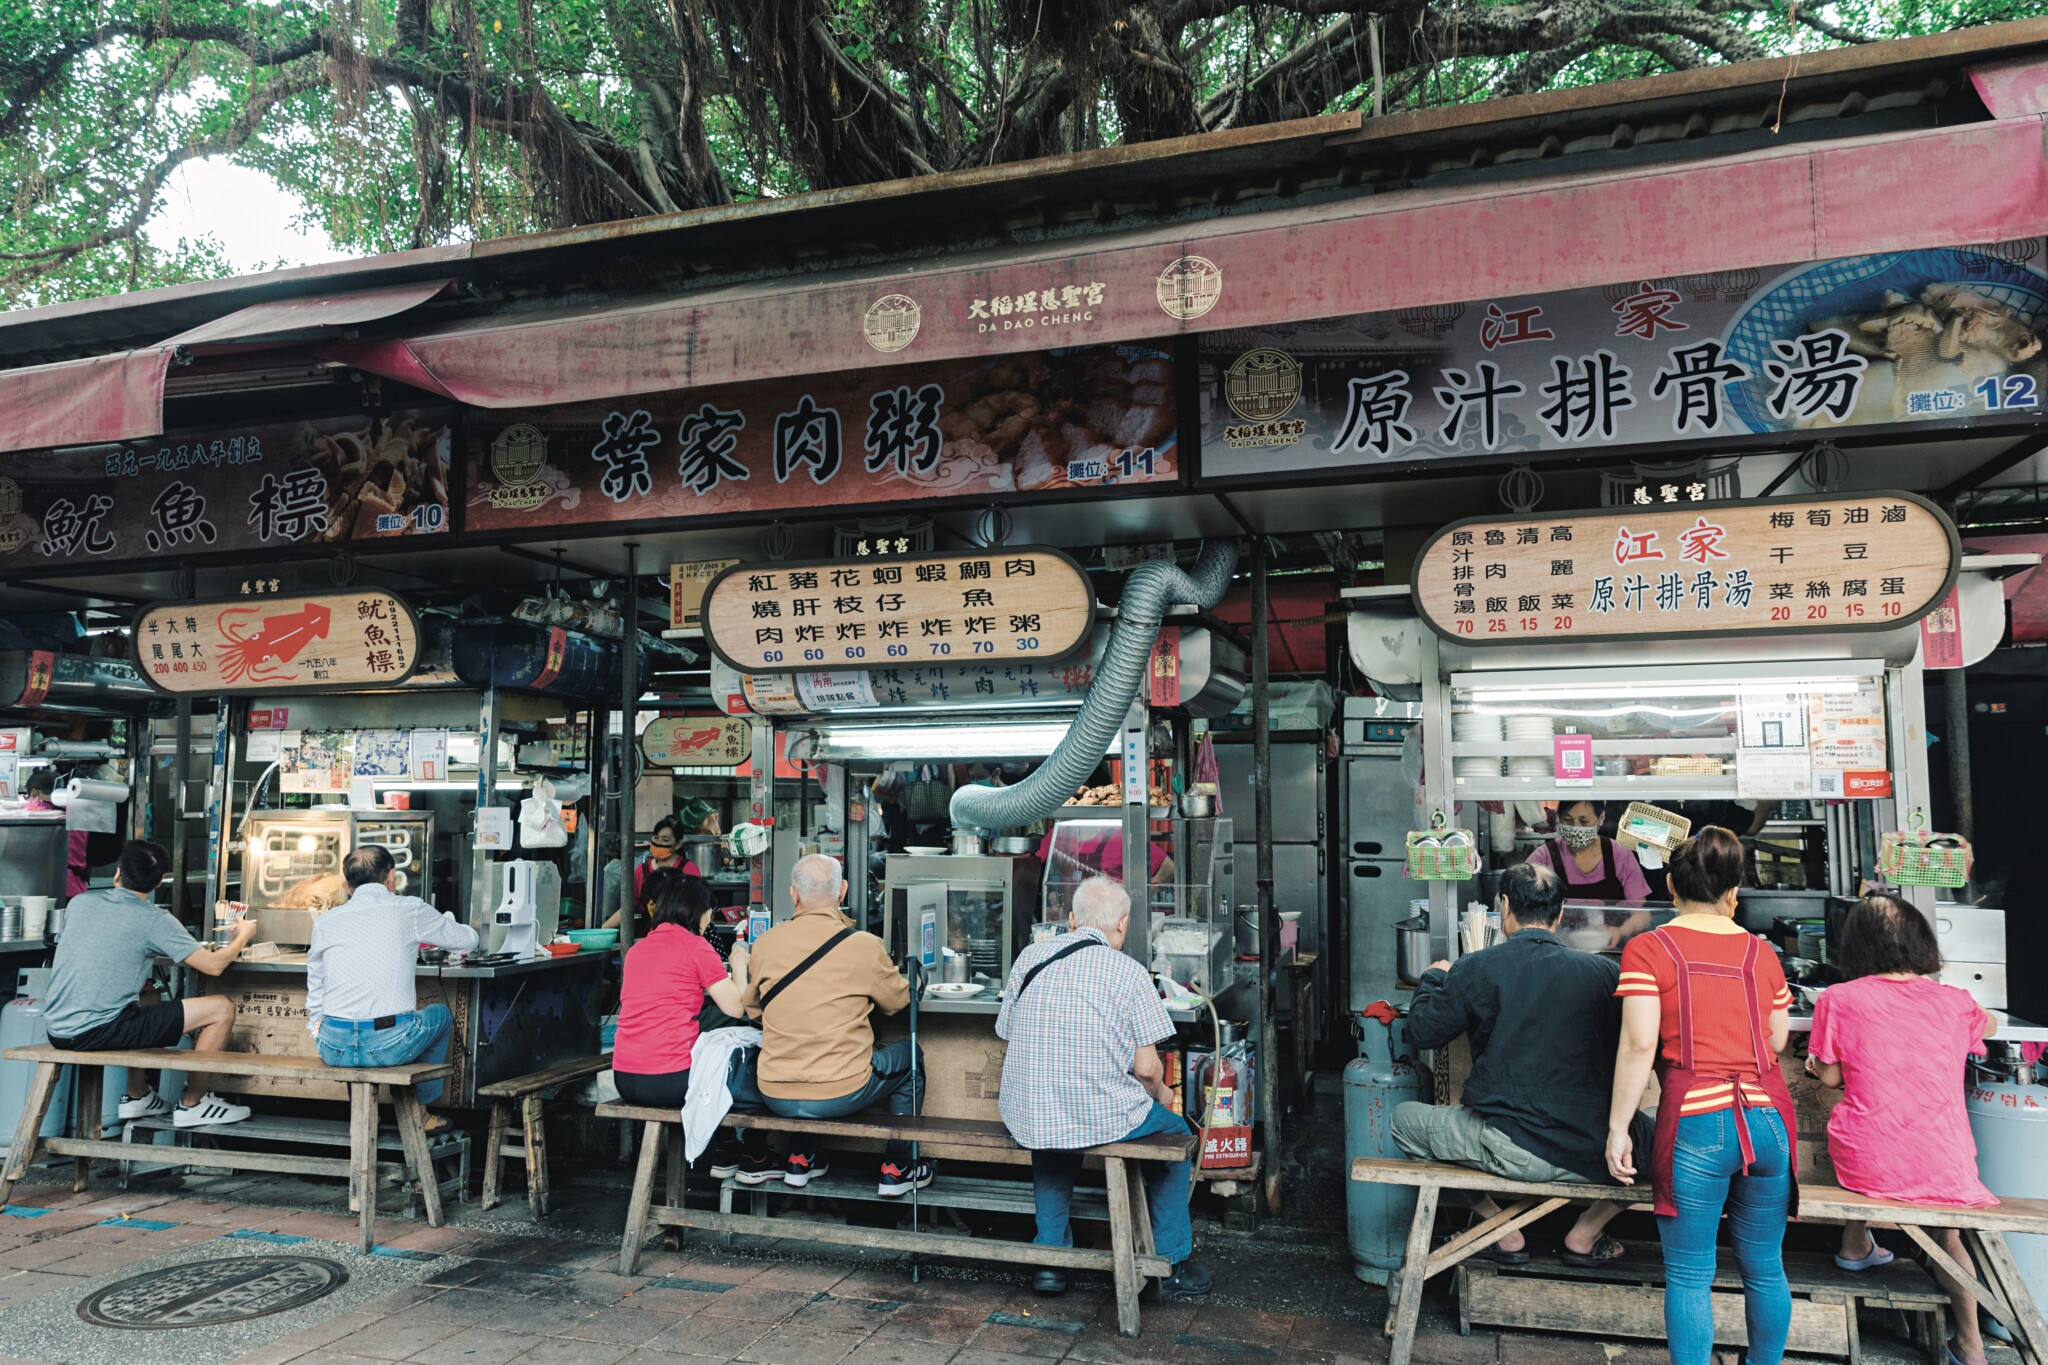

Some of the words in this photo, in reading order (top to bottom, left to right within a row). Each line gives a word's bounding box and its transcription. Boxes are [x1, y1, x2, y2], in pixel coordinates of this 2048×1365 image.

[979, 323, 997, 333] DA
[1004, 319, 1034, 331] DAO
[1041, 311, 1093, 326] CHENG
[1480, 281, 1689, 351] 江家
[1329, 328, 1868, 459] 原汁排骨湯
[1974, 374, 2038, 410] 12
[105, 436, 262, 477] 西元一九五八年創立
[592, 383, 945, 503] 葉家肉粥
[1246, 439, 1264, 447] DAO
[1267, 436, 1298, 445] CHENG
[1116, 447, 1155, 479] 11
[1633, 483, 1707, 505] 慈聖宮
[40, 468, 329, 557] 魷魚標
[411, 503, 443, 531] 10
[856, 537, 910, 556] 慈聖宮
[1615, 515, 1729, 566] 江家
[1769, 511, 1794, 600] 梅干菜
[1806, 508, 1831, 599] 筍絲
[1843, 506, 1869, 597] 油豆腐
[1879, 504, 1906, 596] 滷蛋
[1452, 531, 1475, 614] 原汁排骨湯
[1484, 529, 1508, 613] 魯肉飯
[1517, 527, 1541, 612] 清飯
[1550, 525, 1574, 609] 高麗菜
[788, 571, 825, 642] 豬肝炸
[830, 568, 866, 640] 花枝炸
[872, 566, 909, 638] 蚵仔炸
[915, 563, 952, 637] 蝦炸
[958, 560, 997, 635] 鯛魚炸
[1004, 558, 1041, 633] 肉粥
[1588, 569, 1754, 614] 原汁排骨湯
[1882, 601, 1901, 616] 10
[748, 574, 784, 645] 紅燒肉
[1456, 620, 1474, 633] 70
[1488, 619, 1506, 632] 25
[1520, 617, 1538, 631] 15
[1554, 616, 1572, 630] 20
[1771, 606, 1791, 620] 20
[1807, 605, 1827, 619] 20
[1845, 603, 1864, 617] 15
[148, 619, 164, 660] 半尾
[166, 617, 183, 659] 大尾
[185, 616, 203, 658] 特大
[358, 598, 395, 674] 魷魚標
[845, 646, 866, 658] 60
[887, 644, 908, 656] 60
[929, 642, 951, 654] 70
[972, 641, 994, 653] 70
[1016, 637, 1039, 650] 30
[153, 663, 169, 673] 200
[173, 662, 188, 672] 400
[192, 661, 207, 672] 450
[298, 658, 338, 668] 一九五八年
[763, 650, 784, 662] 60
[804, 648, 825, 660] 60
[313, 670, 330, 679] 創立
[725, 723, 740, 758] 魷魚標
[1204, 1137, 1248, 1153] 滅火器
